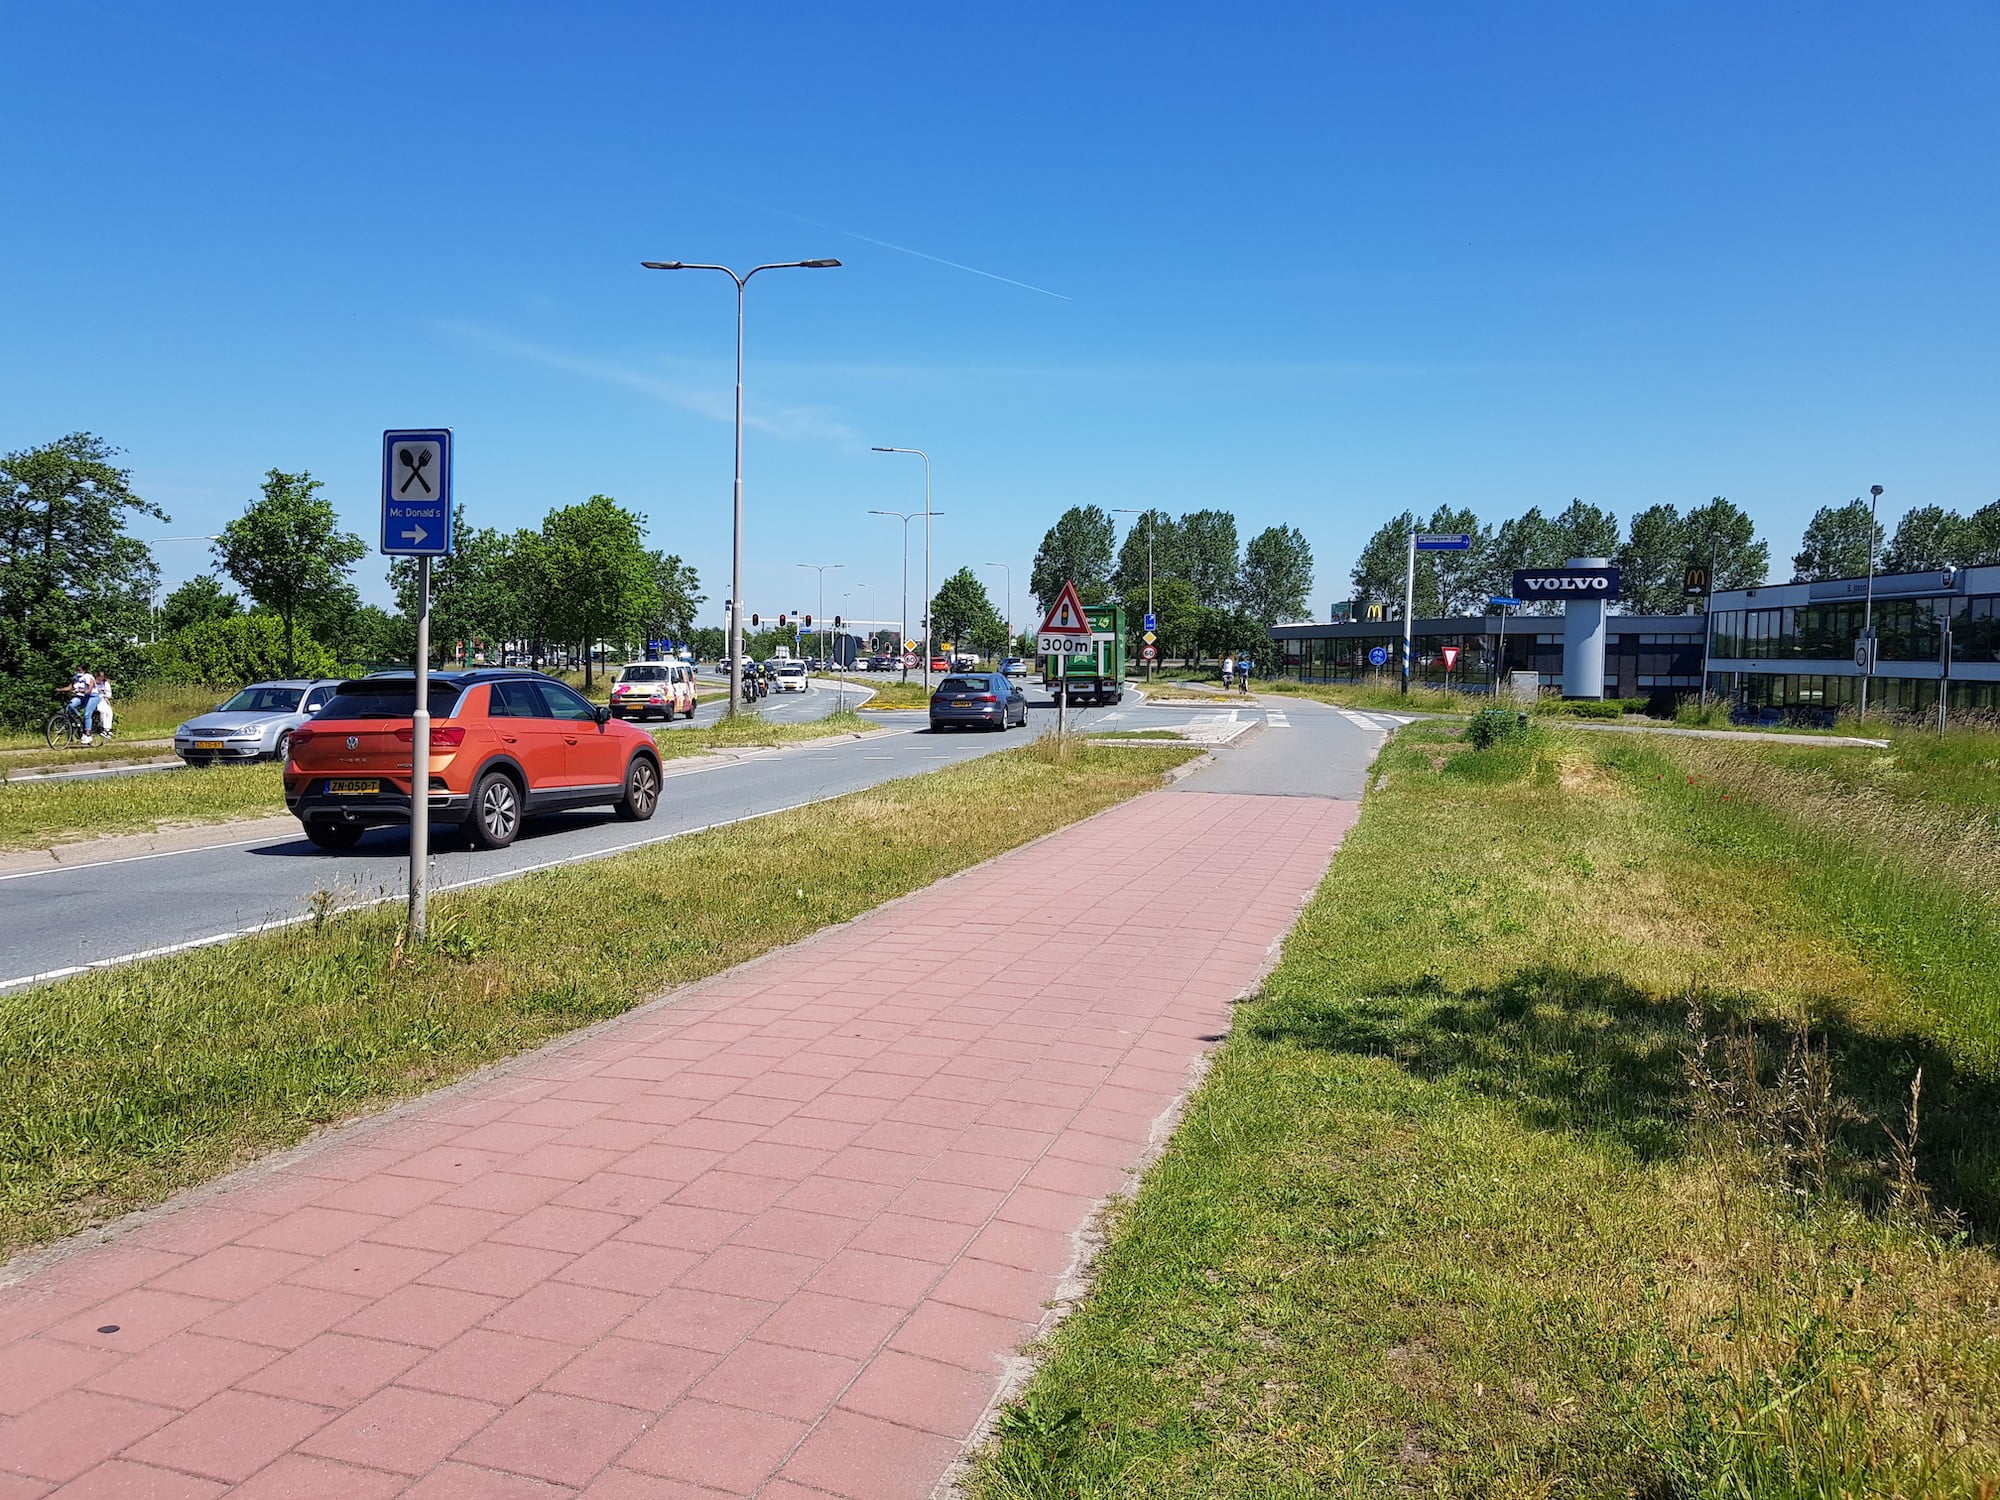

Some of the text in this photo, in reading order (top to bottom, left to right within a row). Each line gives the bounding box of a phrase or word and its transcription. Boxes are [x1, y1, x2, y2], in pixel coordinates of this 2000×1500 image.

[390, 508, 441, 517] Mc Donald's
[1524, 577, 1609, 590] VOLVO
[331, 781, 377, 792] ZN-050-T
